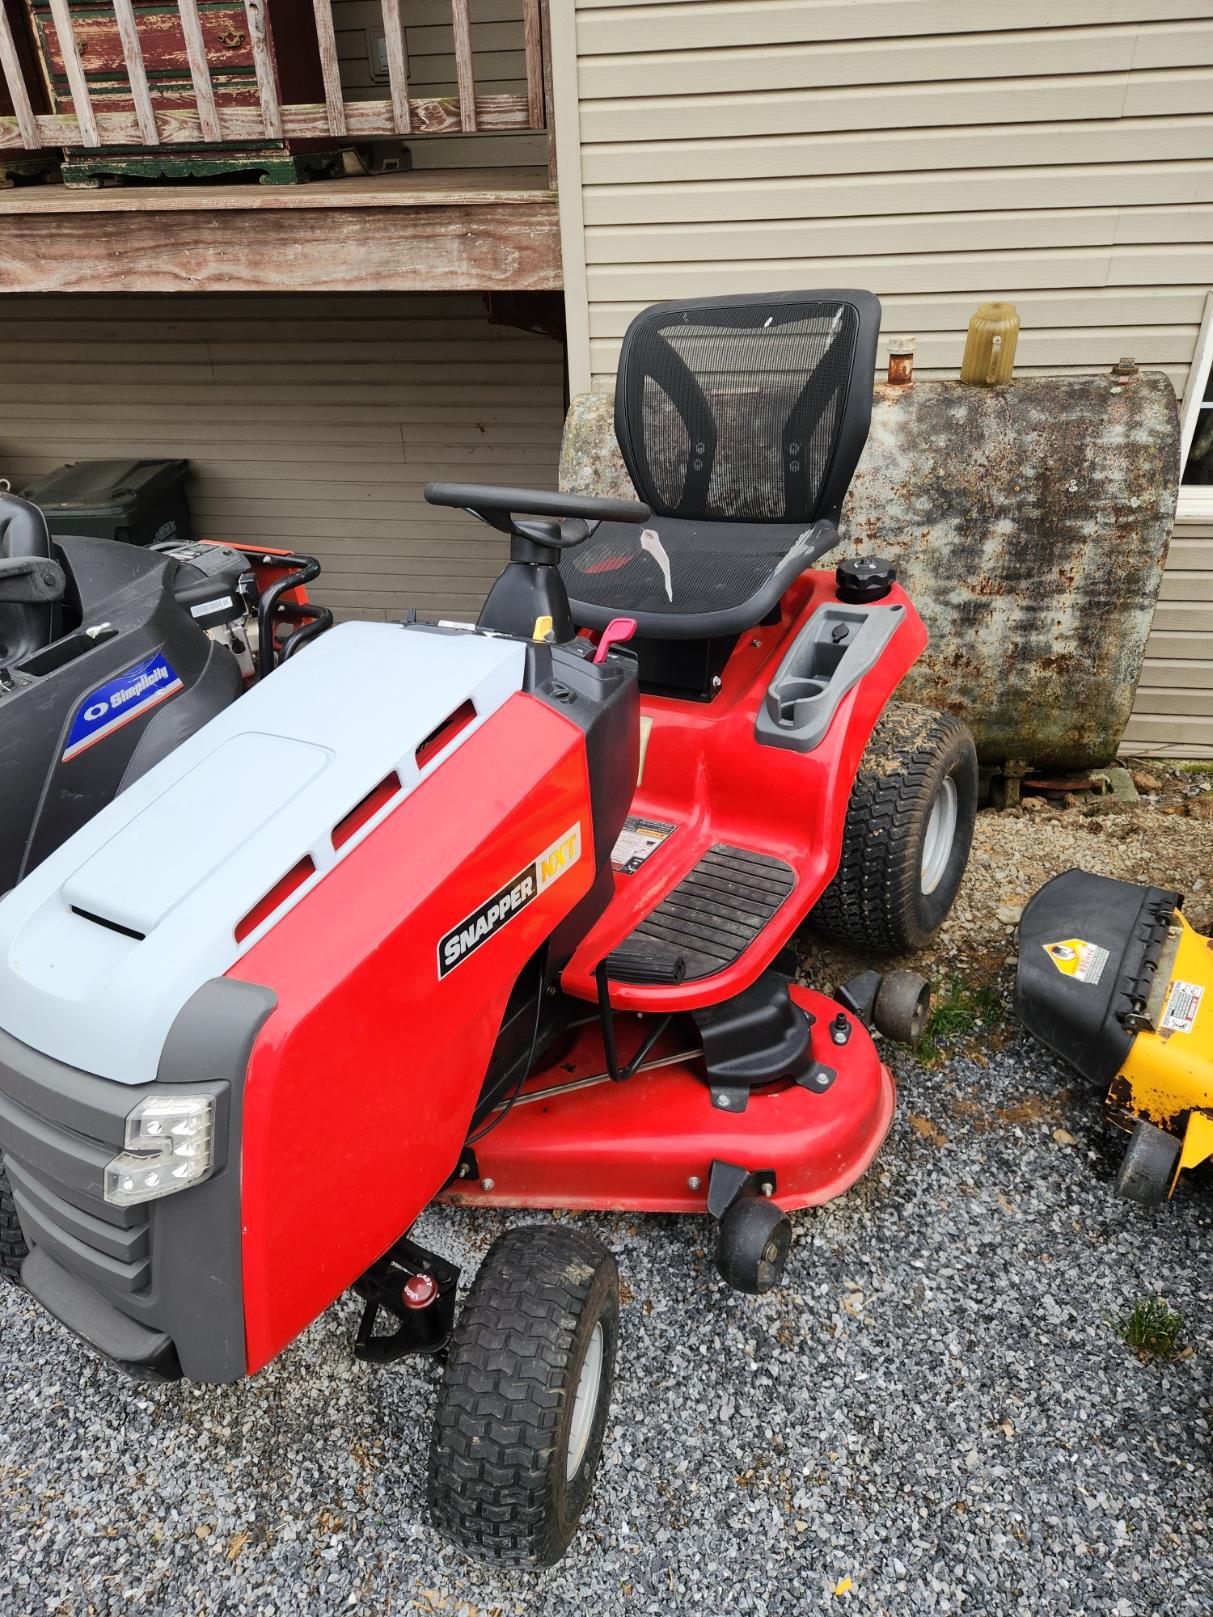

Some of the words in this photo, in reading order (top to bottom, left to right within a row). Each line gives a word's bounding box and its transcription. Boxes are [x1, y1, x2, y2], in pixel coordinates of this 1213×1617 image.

[110, 666, 169, 708] Simplicity
[444, 876, 535, 966] SNAPPER
[540, 833, 577, 883] NXT
